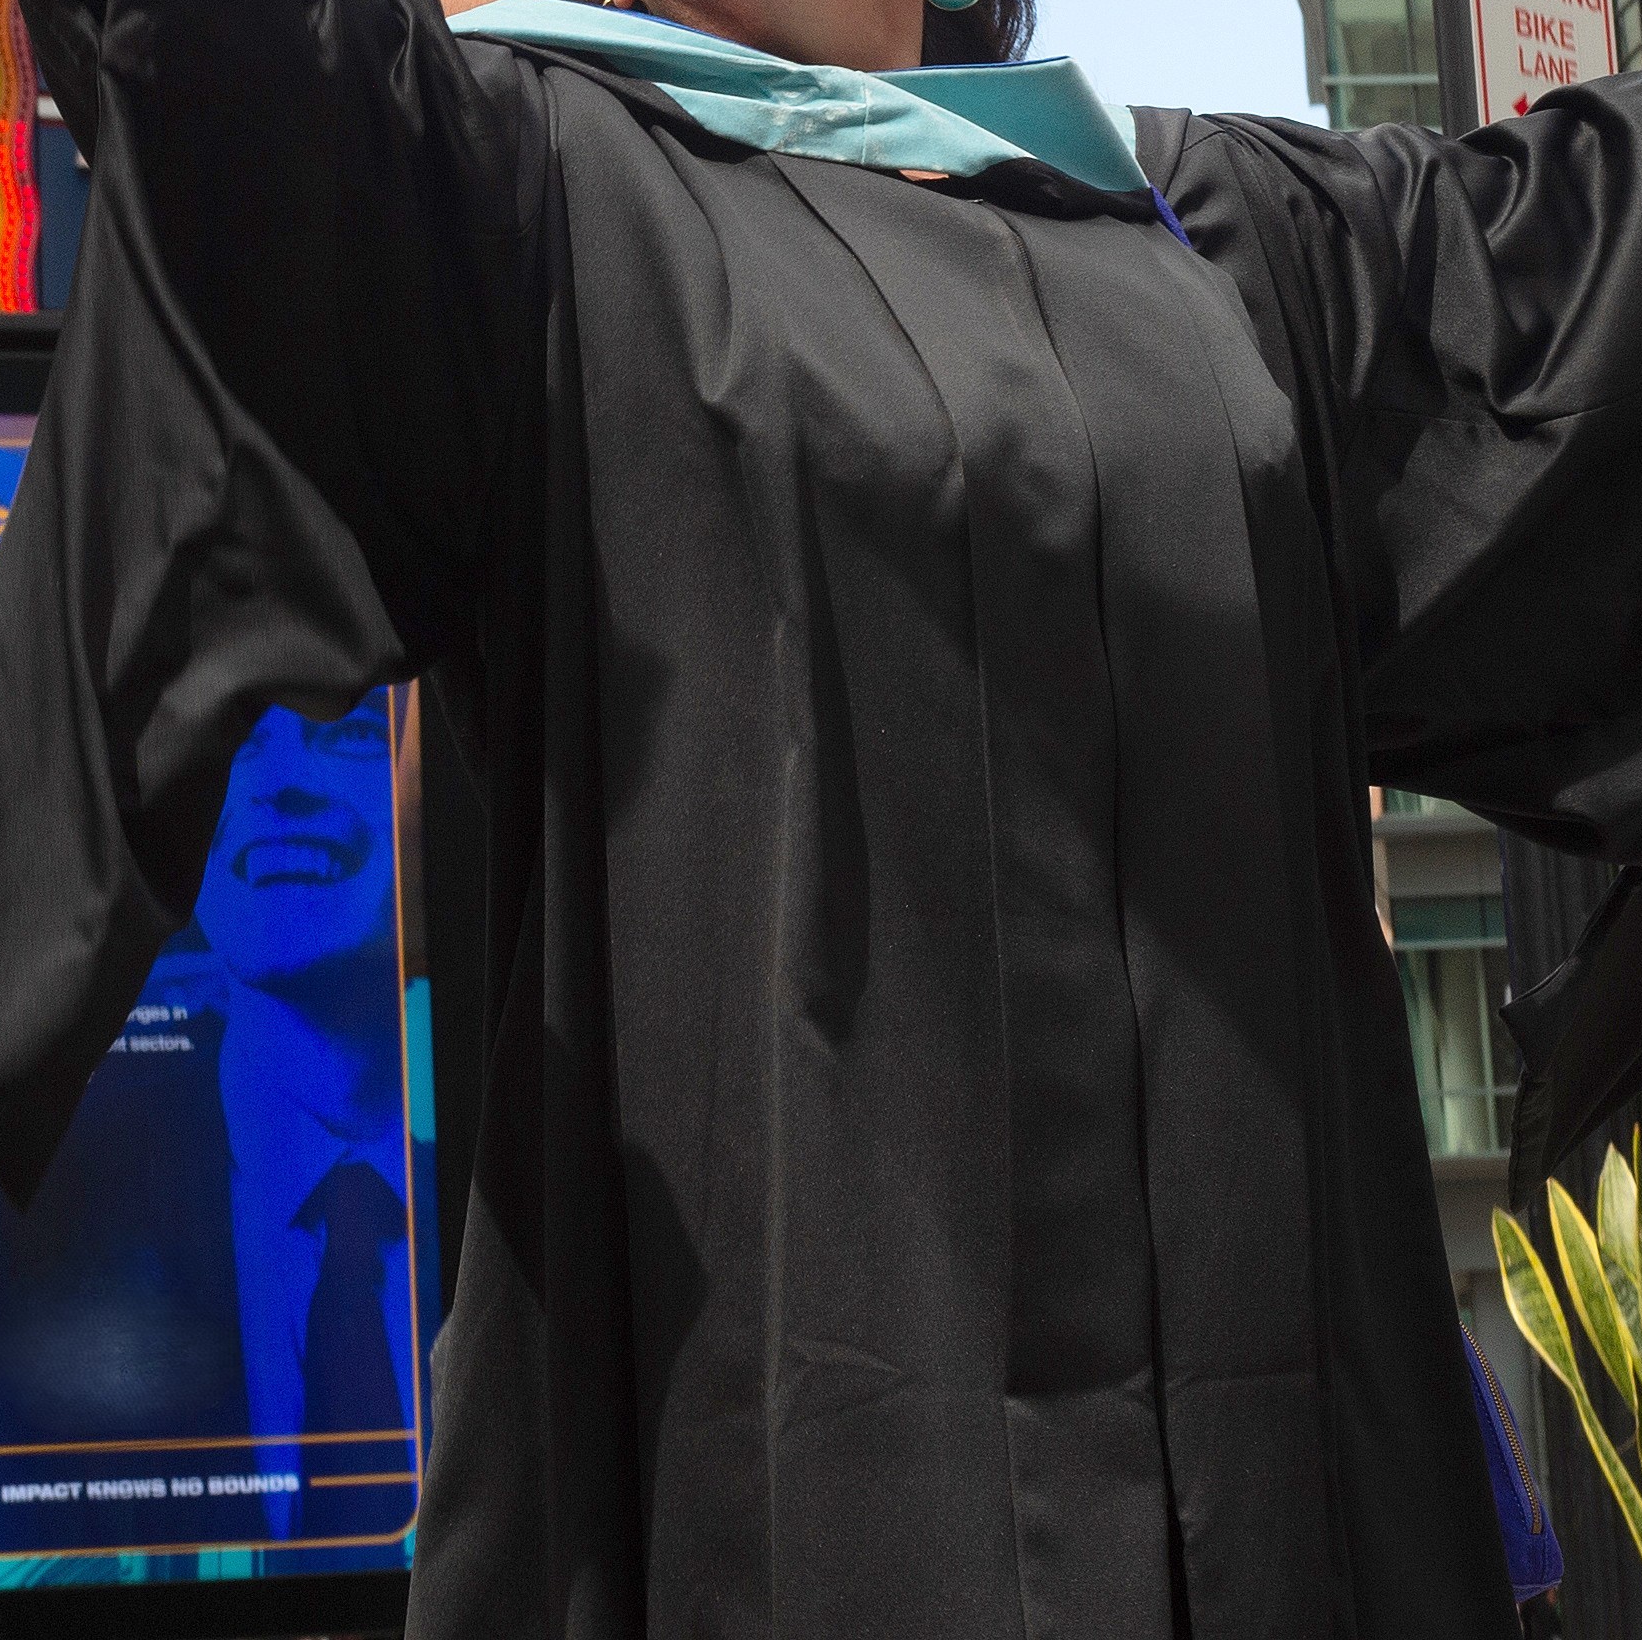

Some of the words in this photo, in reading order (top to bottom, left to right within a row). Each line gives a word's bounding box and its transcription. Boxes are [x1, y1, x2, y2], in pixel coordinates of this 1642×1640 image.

[1514, 7, 1576, 51] BIKE
[1518, 45, 1578, 85] LANE
[2, 1481, 83, 1504] IMPACT
[86, 1477, 168, 1500] KNOWS
[170, 1476, 204, 1497] NO
[207, 1473, 300, 1496] BOUNDS
